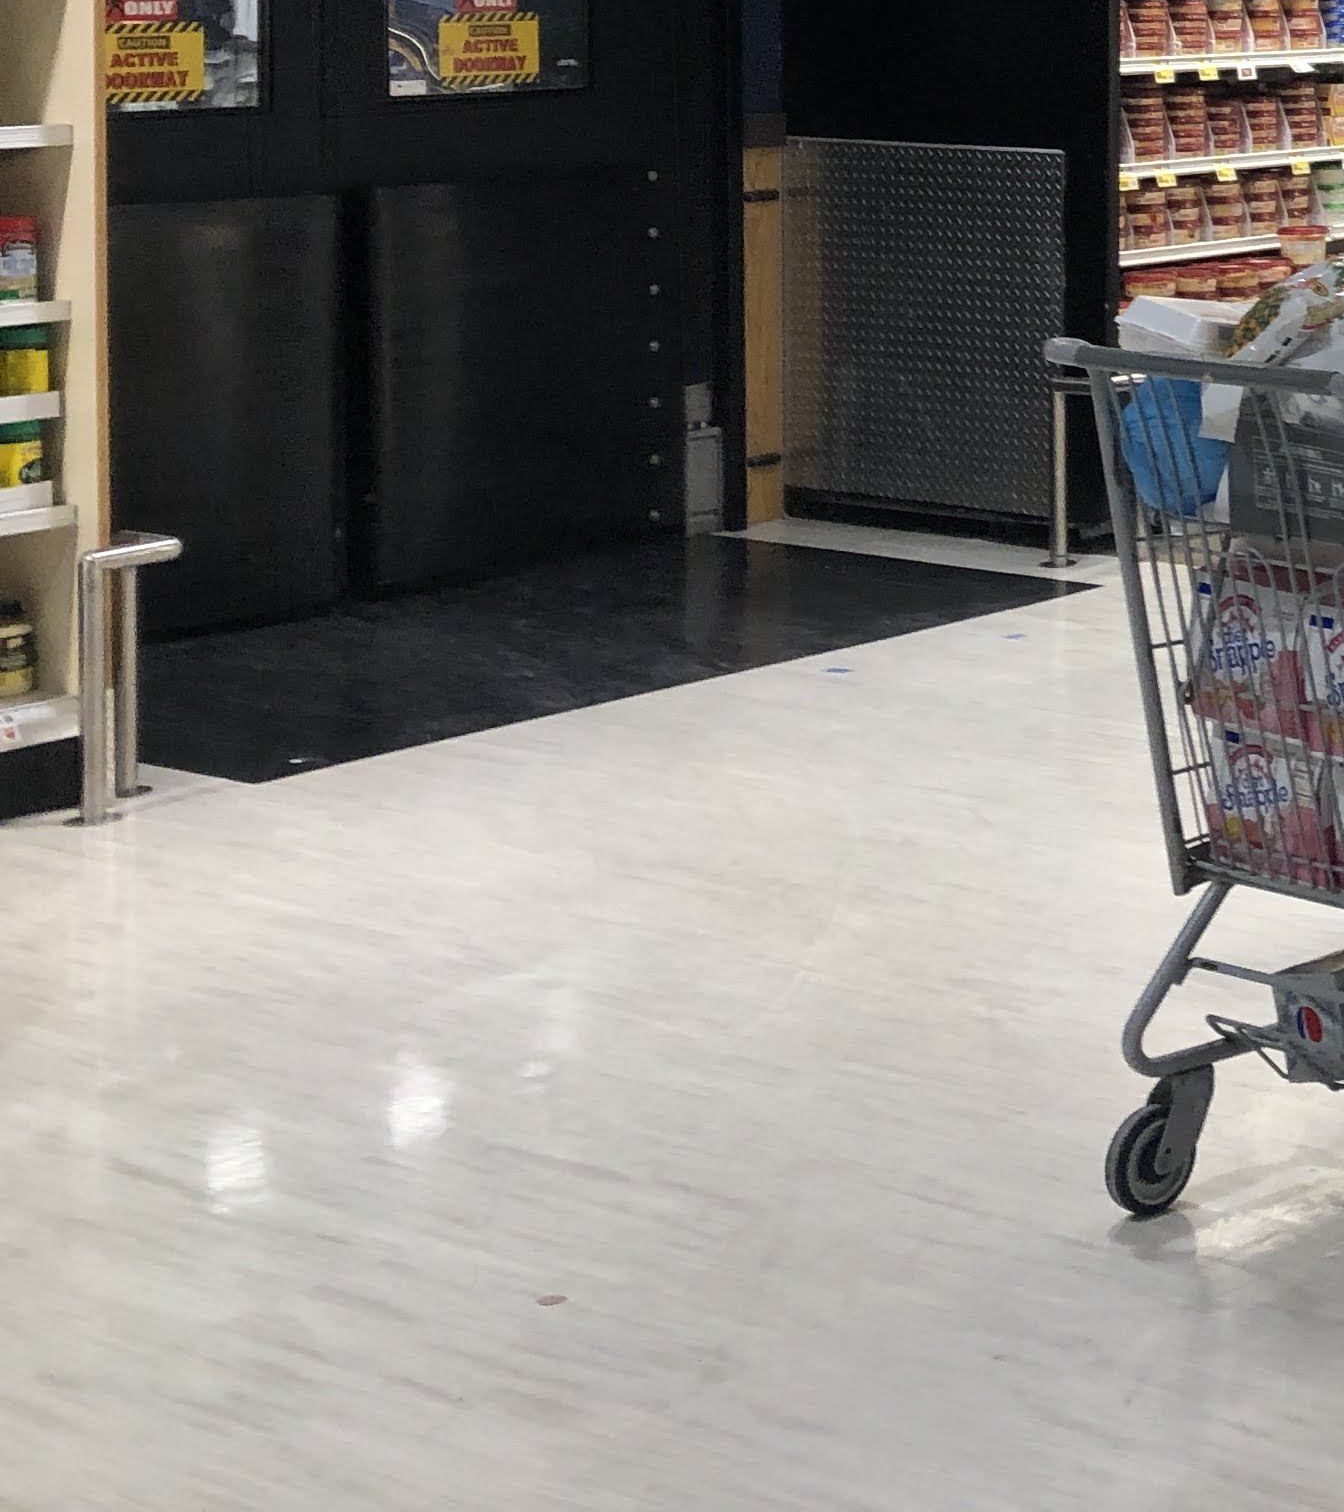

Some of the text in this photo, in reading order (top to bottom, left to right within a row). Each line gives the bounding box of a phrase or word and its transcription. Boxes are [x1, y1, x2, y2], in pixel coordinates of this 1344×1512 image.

[124, 0, 173, 16] ONLY
[462, 39, 518, 53] ACTIVE
[110, 52, 178, 68] ACTIVE
